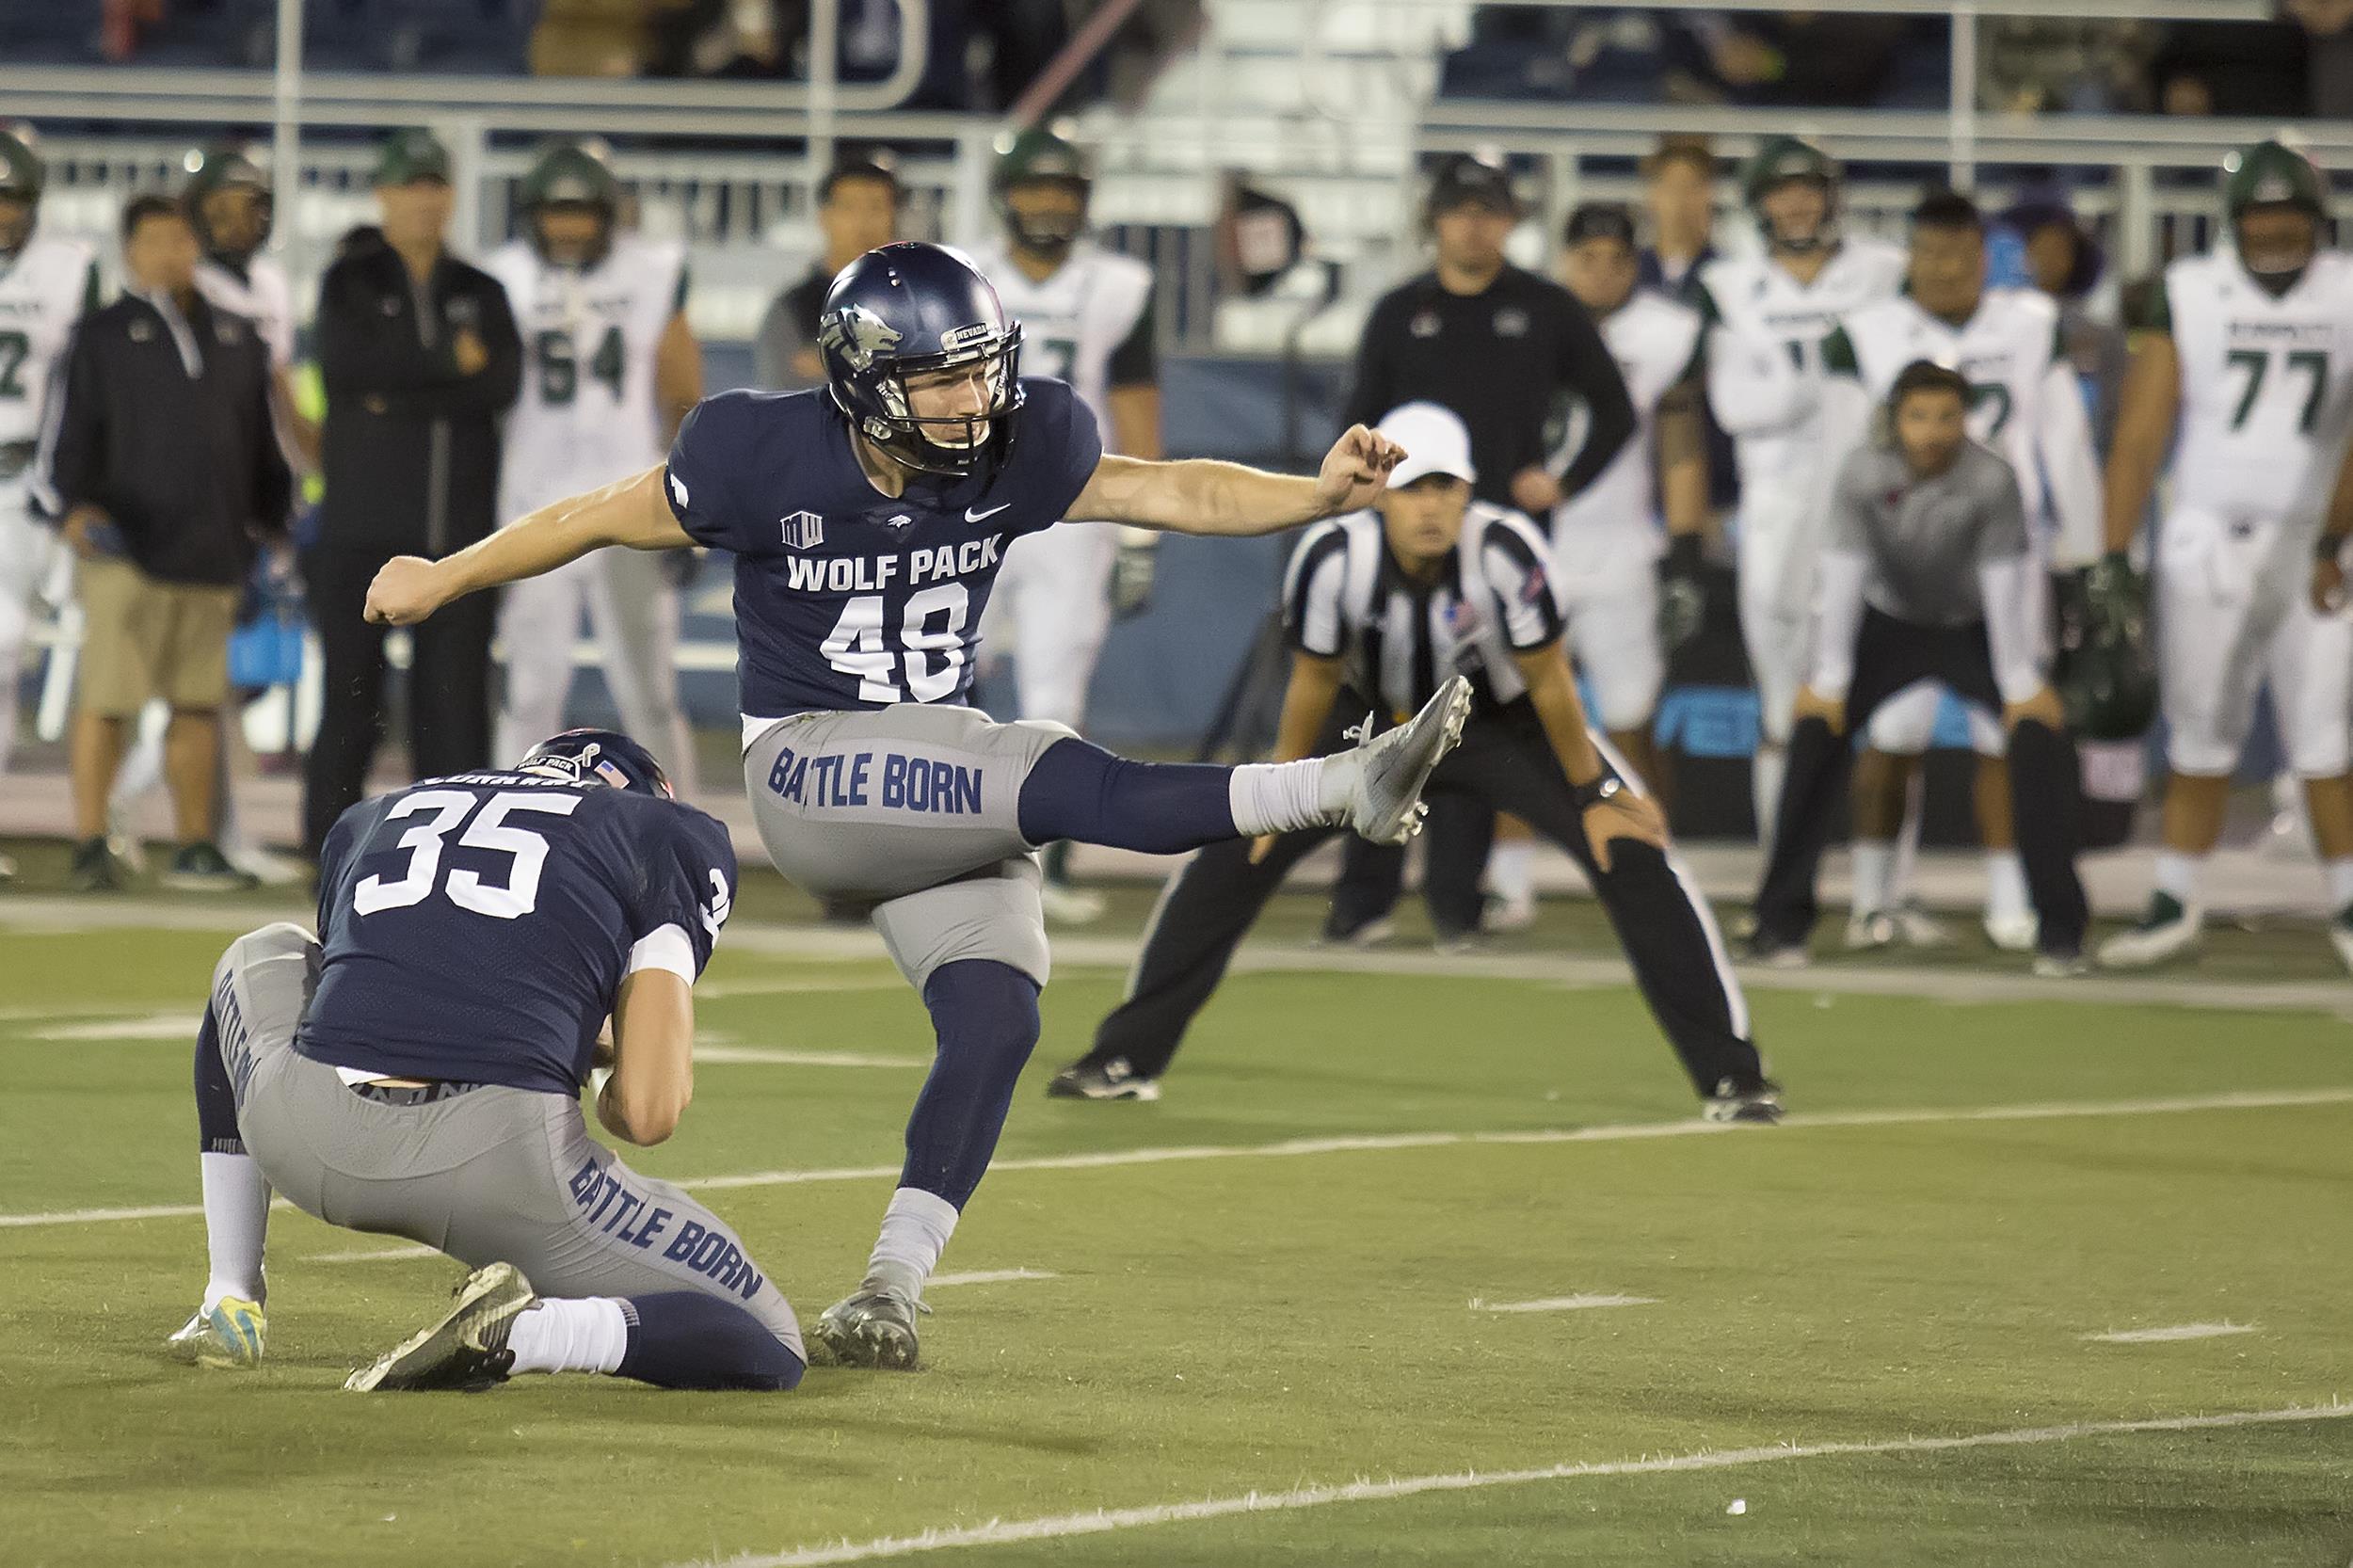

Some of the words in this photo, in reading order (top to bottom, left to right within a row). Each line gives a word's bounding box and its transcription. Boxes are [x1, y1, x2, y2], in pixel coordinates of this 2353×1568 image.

[537, 327, 624, 407] 54
[955, 324, 987, 341] NEVADA
[2227, 349, 2328, 433] 77
[787, 554, 898, 592] WOLF
[909, 533, 1003, 585] PACK
[820, 581, 969, 704] 48
[546, 758, 574, 771] PACK
[768, 746, 873, 807] BATLE
[882, 753, 983, 814] BORN
[353, 790, 584, 920] 35
[568, 1157, 674, 1249] BATTLE
[662, 1220, 764, 1301] BORN
